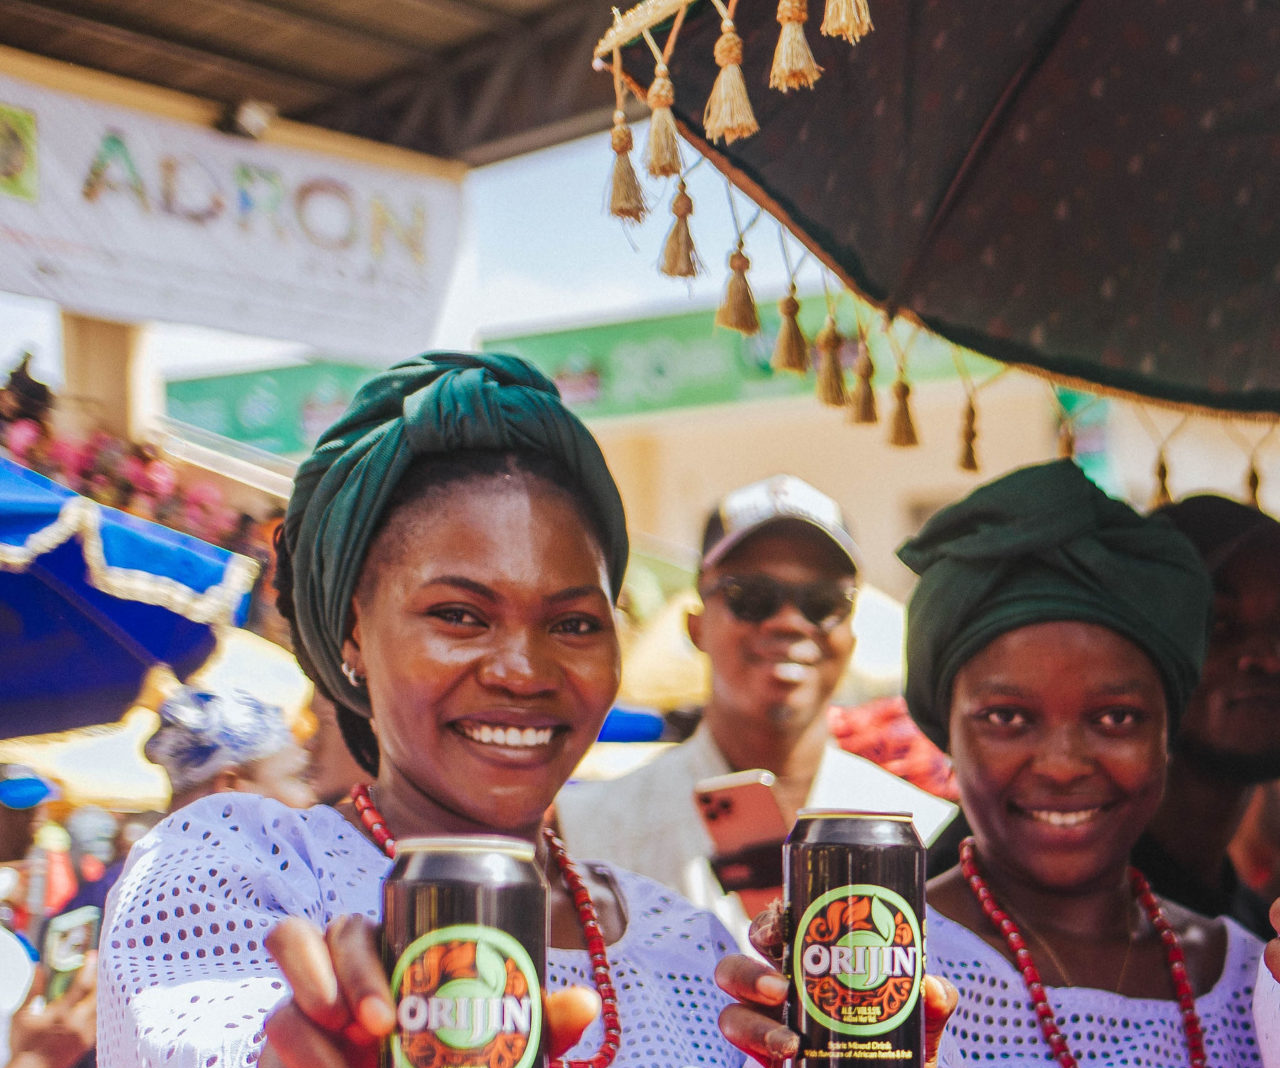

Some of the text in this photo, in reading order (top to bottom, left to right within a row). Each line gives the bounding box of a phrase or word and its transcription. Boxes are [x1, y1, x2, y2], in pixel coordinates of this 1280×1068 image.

[82, 128, 428, 267] ADRON
[803, 944, 917, 986] ORIJIN
[397, 994, 530, 1041] ORIJIN
